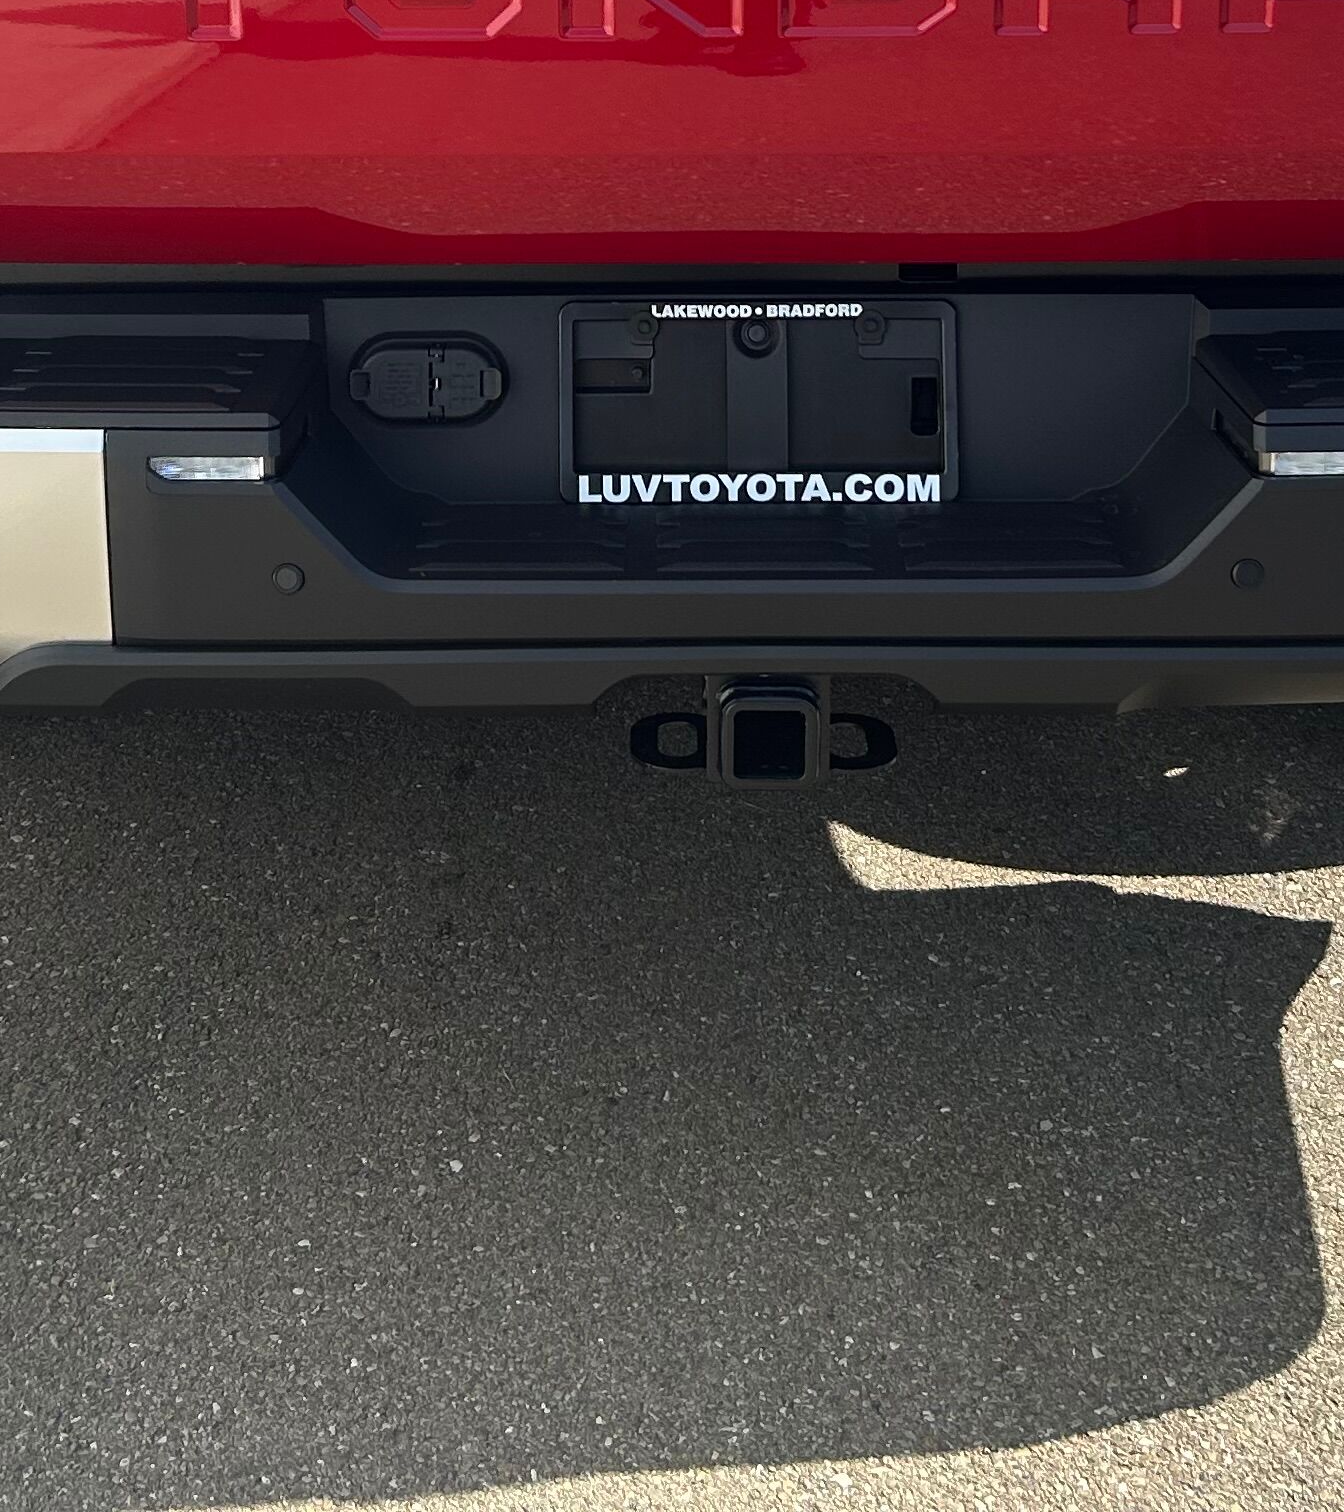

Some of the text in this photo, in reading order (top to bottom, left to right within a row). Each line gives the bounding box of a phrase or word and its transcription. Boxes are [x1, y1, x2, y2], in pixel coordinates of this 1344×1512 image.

[651, 303, 863, 318] LAKEWOOD BRADFORD
[578, 473, 941, 503] LUVTOYOTA.COM
